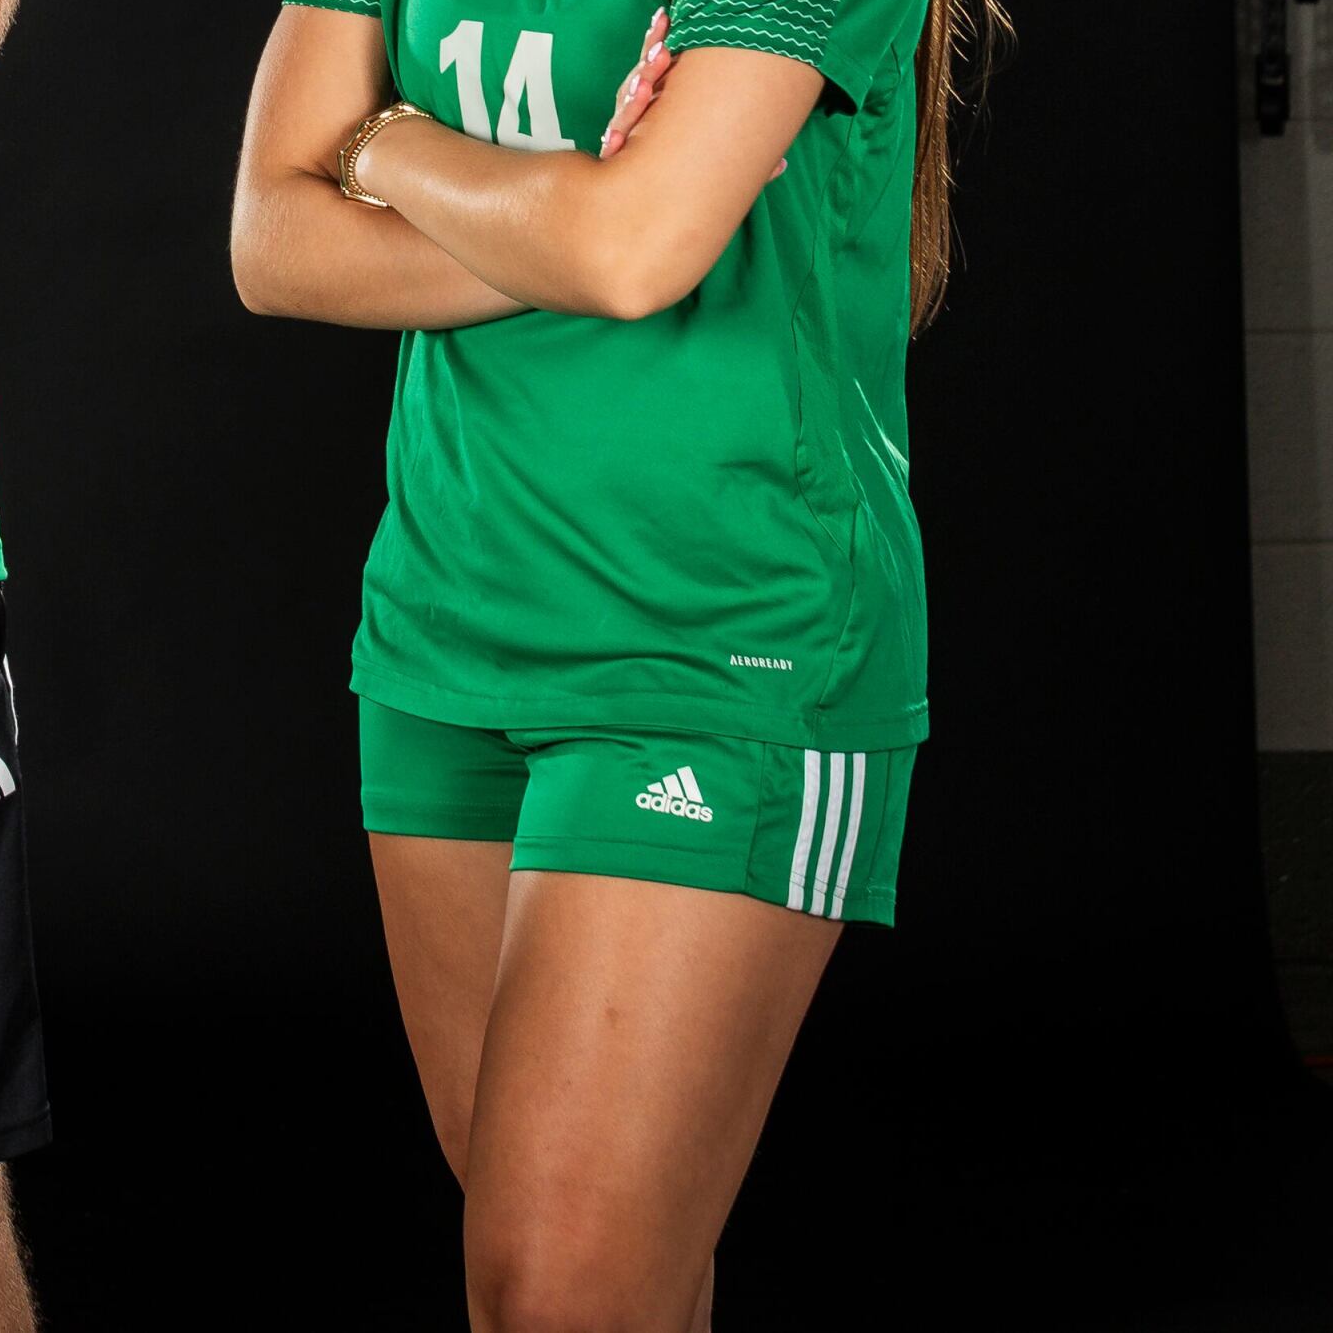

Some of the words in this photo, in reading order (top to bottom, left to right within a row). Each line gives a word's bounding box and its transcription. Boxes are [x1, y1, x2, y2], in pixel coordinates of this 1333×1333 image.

[439, 19, 577, 153] 14
[729, 654, 794, 671] AEROREADY
[635, 791, 714, 823] adidas
